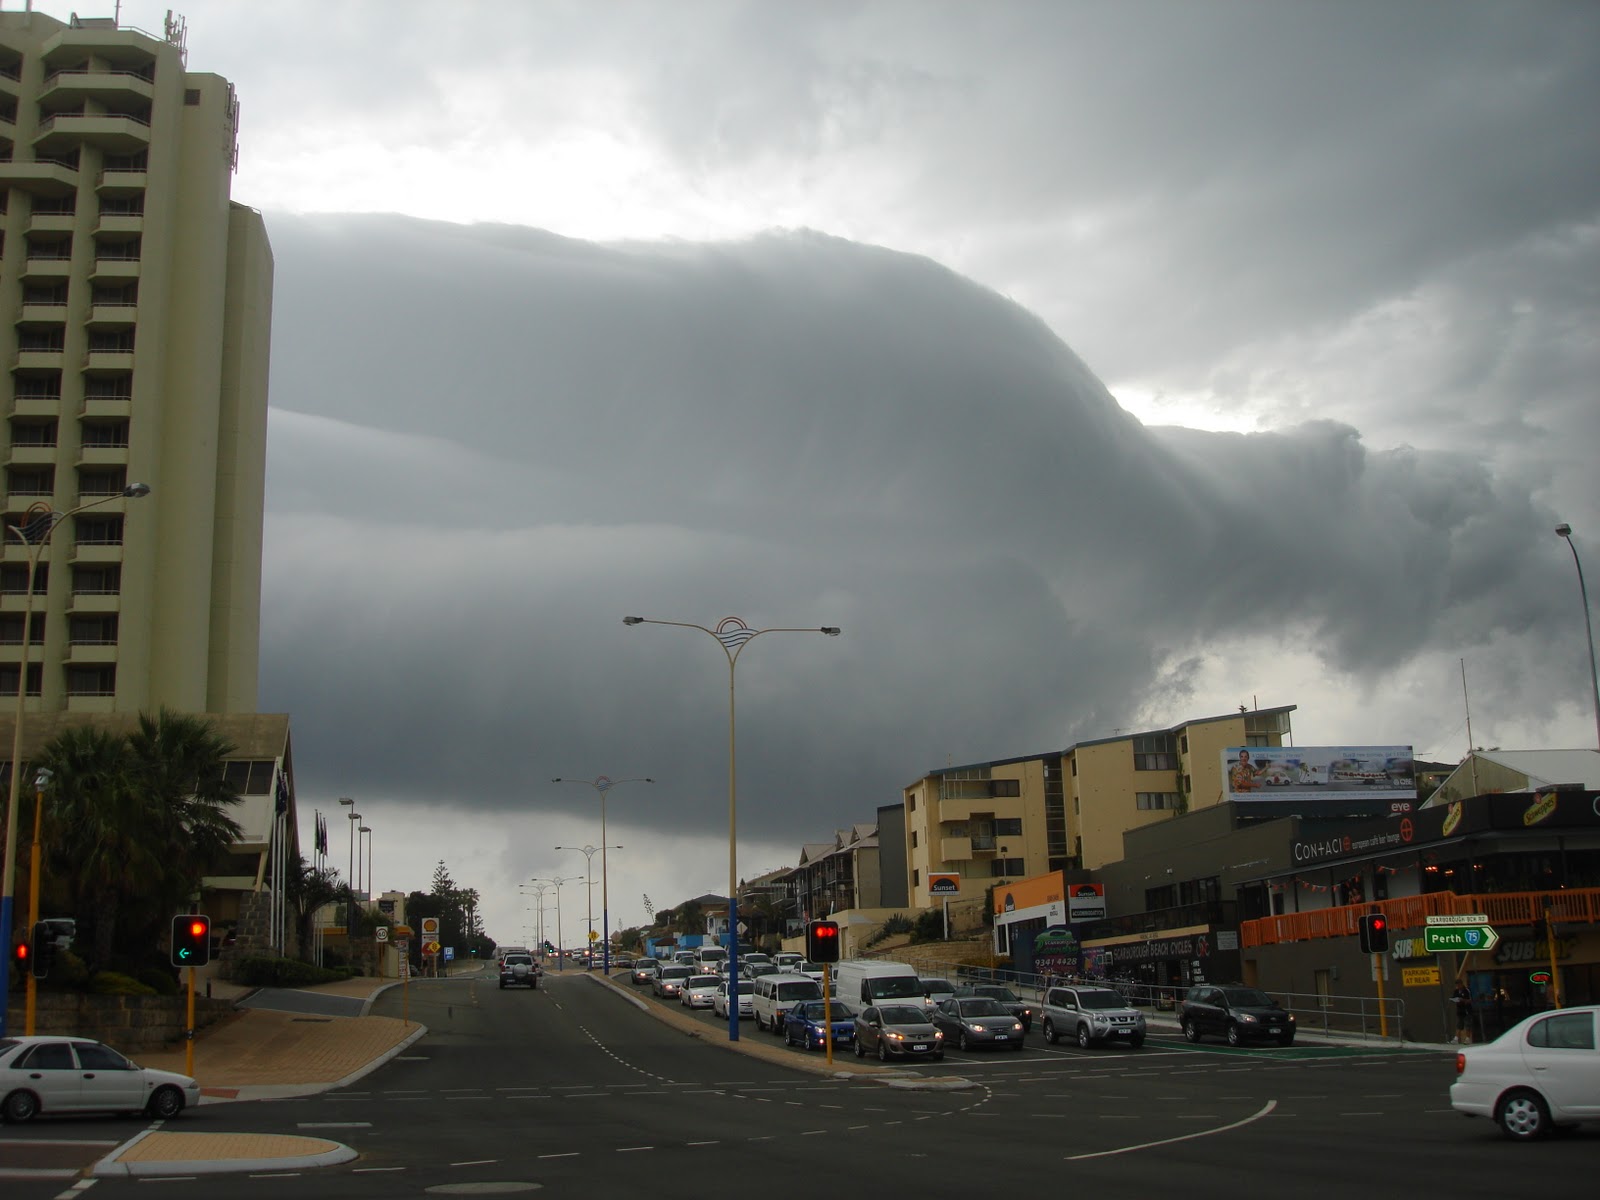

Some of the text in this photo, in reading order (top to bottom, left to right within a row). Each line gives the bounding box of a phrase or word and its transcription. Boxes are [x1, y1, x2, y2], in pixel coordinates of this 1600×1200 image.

[1391, 802, 1410, 811] eye
[1432, 932, 1478, 943] Perth 75
[1113, 939, 1193, 960] SCARBOROUGH BEACH CYCLES
[1392, 938, 1430, 960] SUBW
[1034, 957, 1078, 967] 9341 4428
